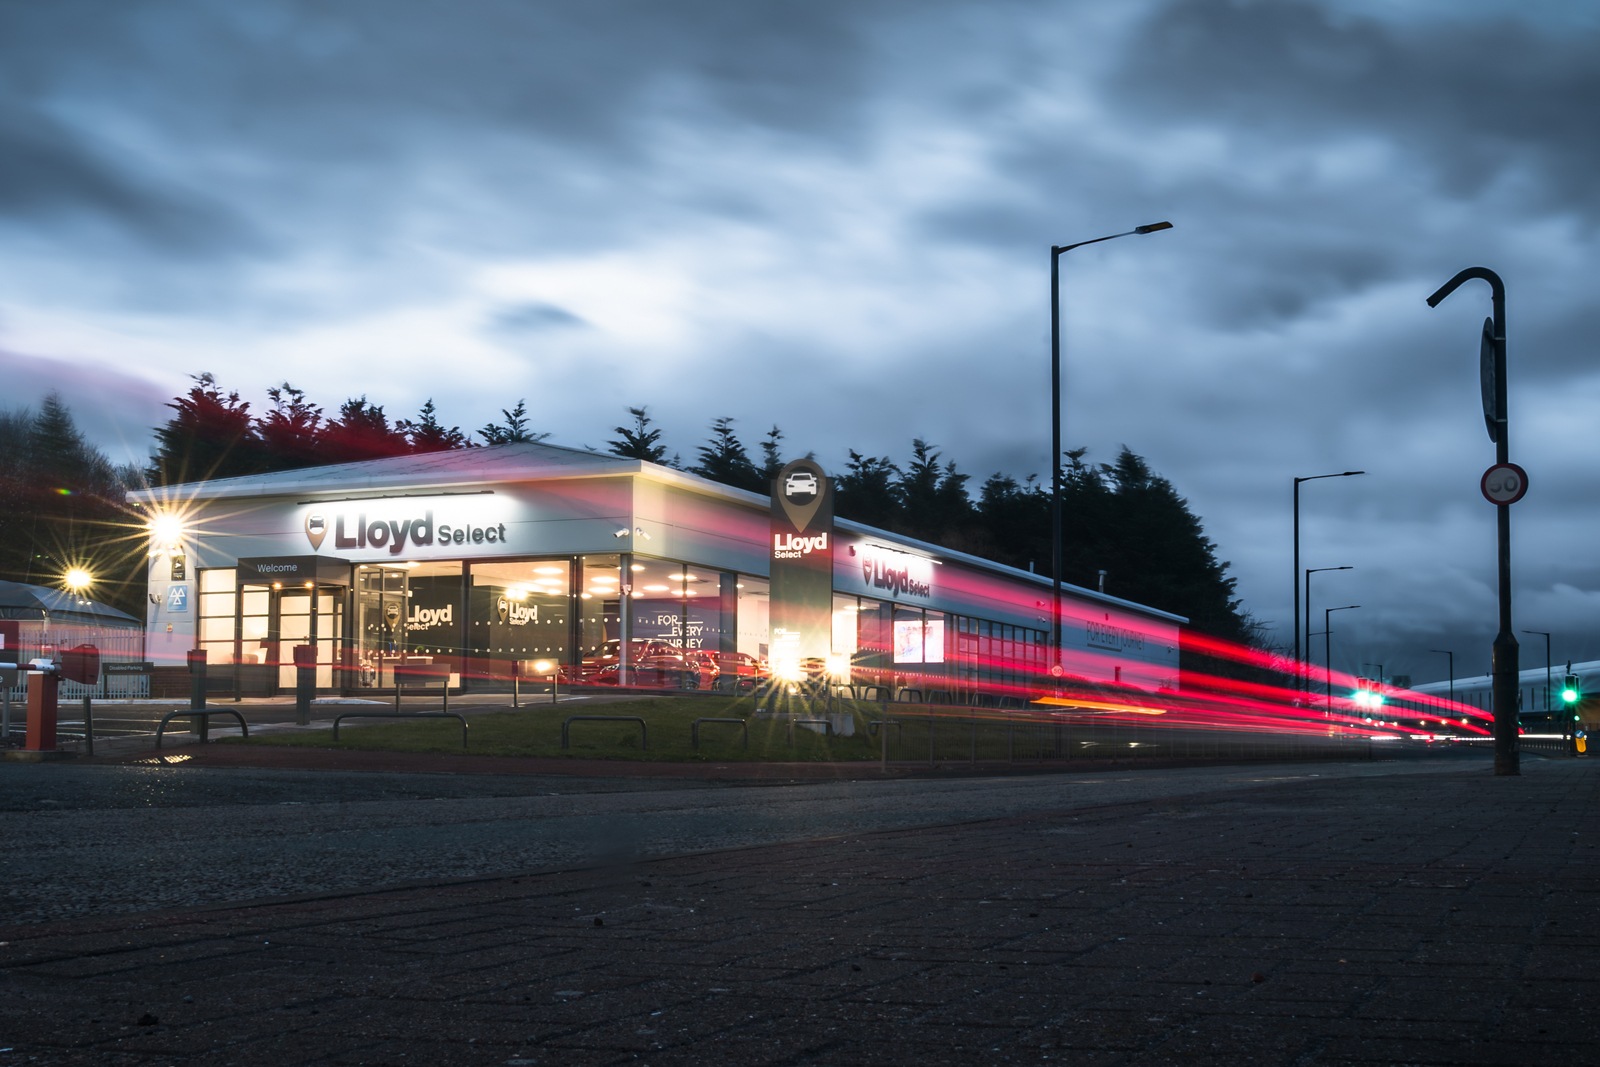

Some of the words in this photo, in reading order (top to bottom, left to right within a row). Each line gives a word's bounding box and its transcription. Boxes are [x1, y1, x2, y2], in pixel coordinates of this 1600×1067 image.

[1490, 476, 1518, 493] 50
[335, 510, 433, 553] Lloyd
[438, 523, 506, 543] Select
[774, 532, 828, 554] Lloyd
[774, 550, 802, 559] Select
[257, 564, 298, 573] Welcome
[874, 558, 908, 598] Lloyd
[909, 579, 930, 598] Select
[509, 601, 538, 622] Lloyd
[657, 614, 678, 627] FOR
[1086, 620, 1100, 642] FOR
